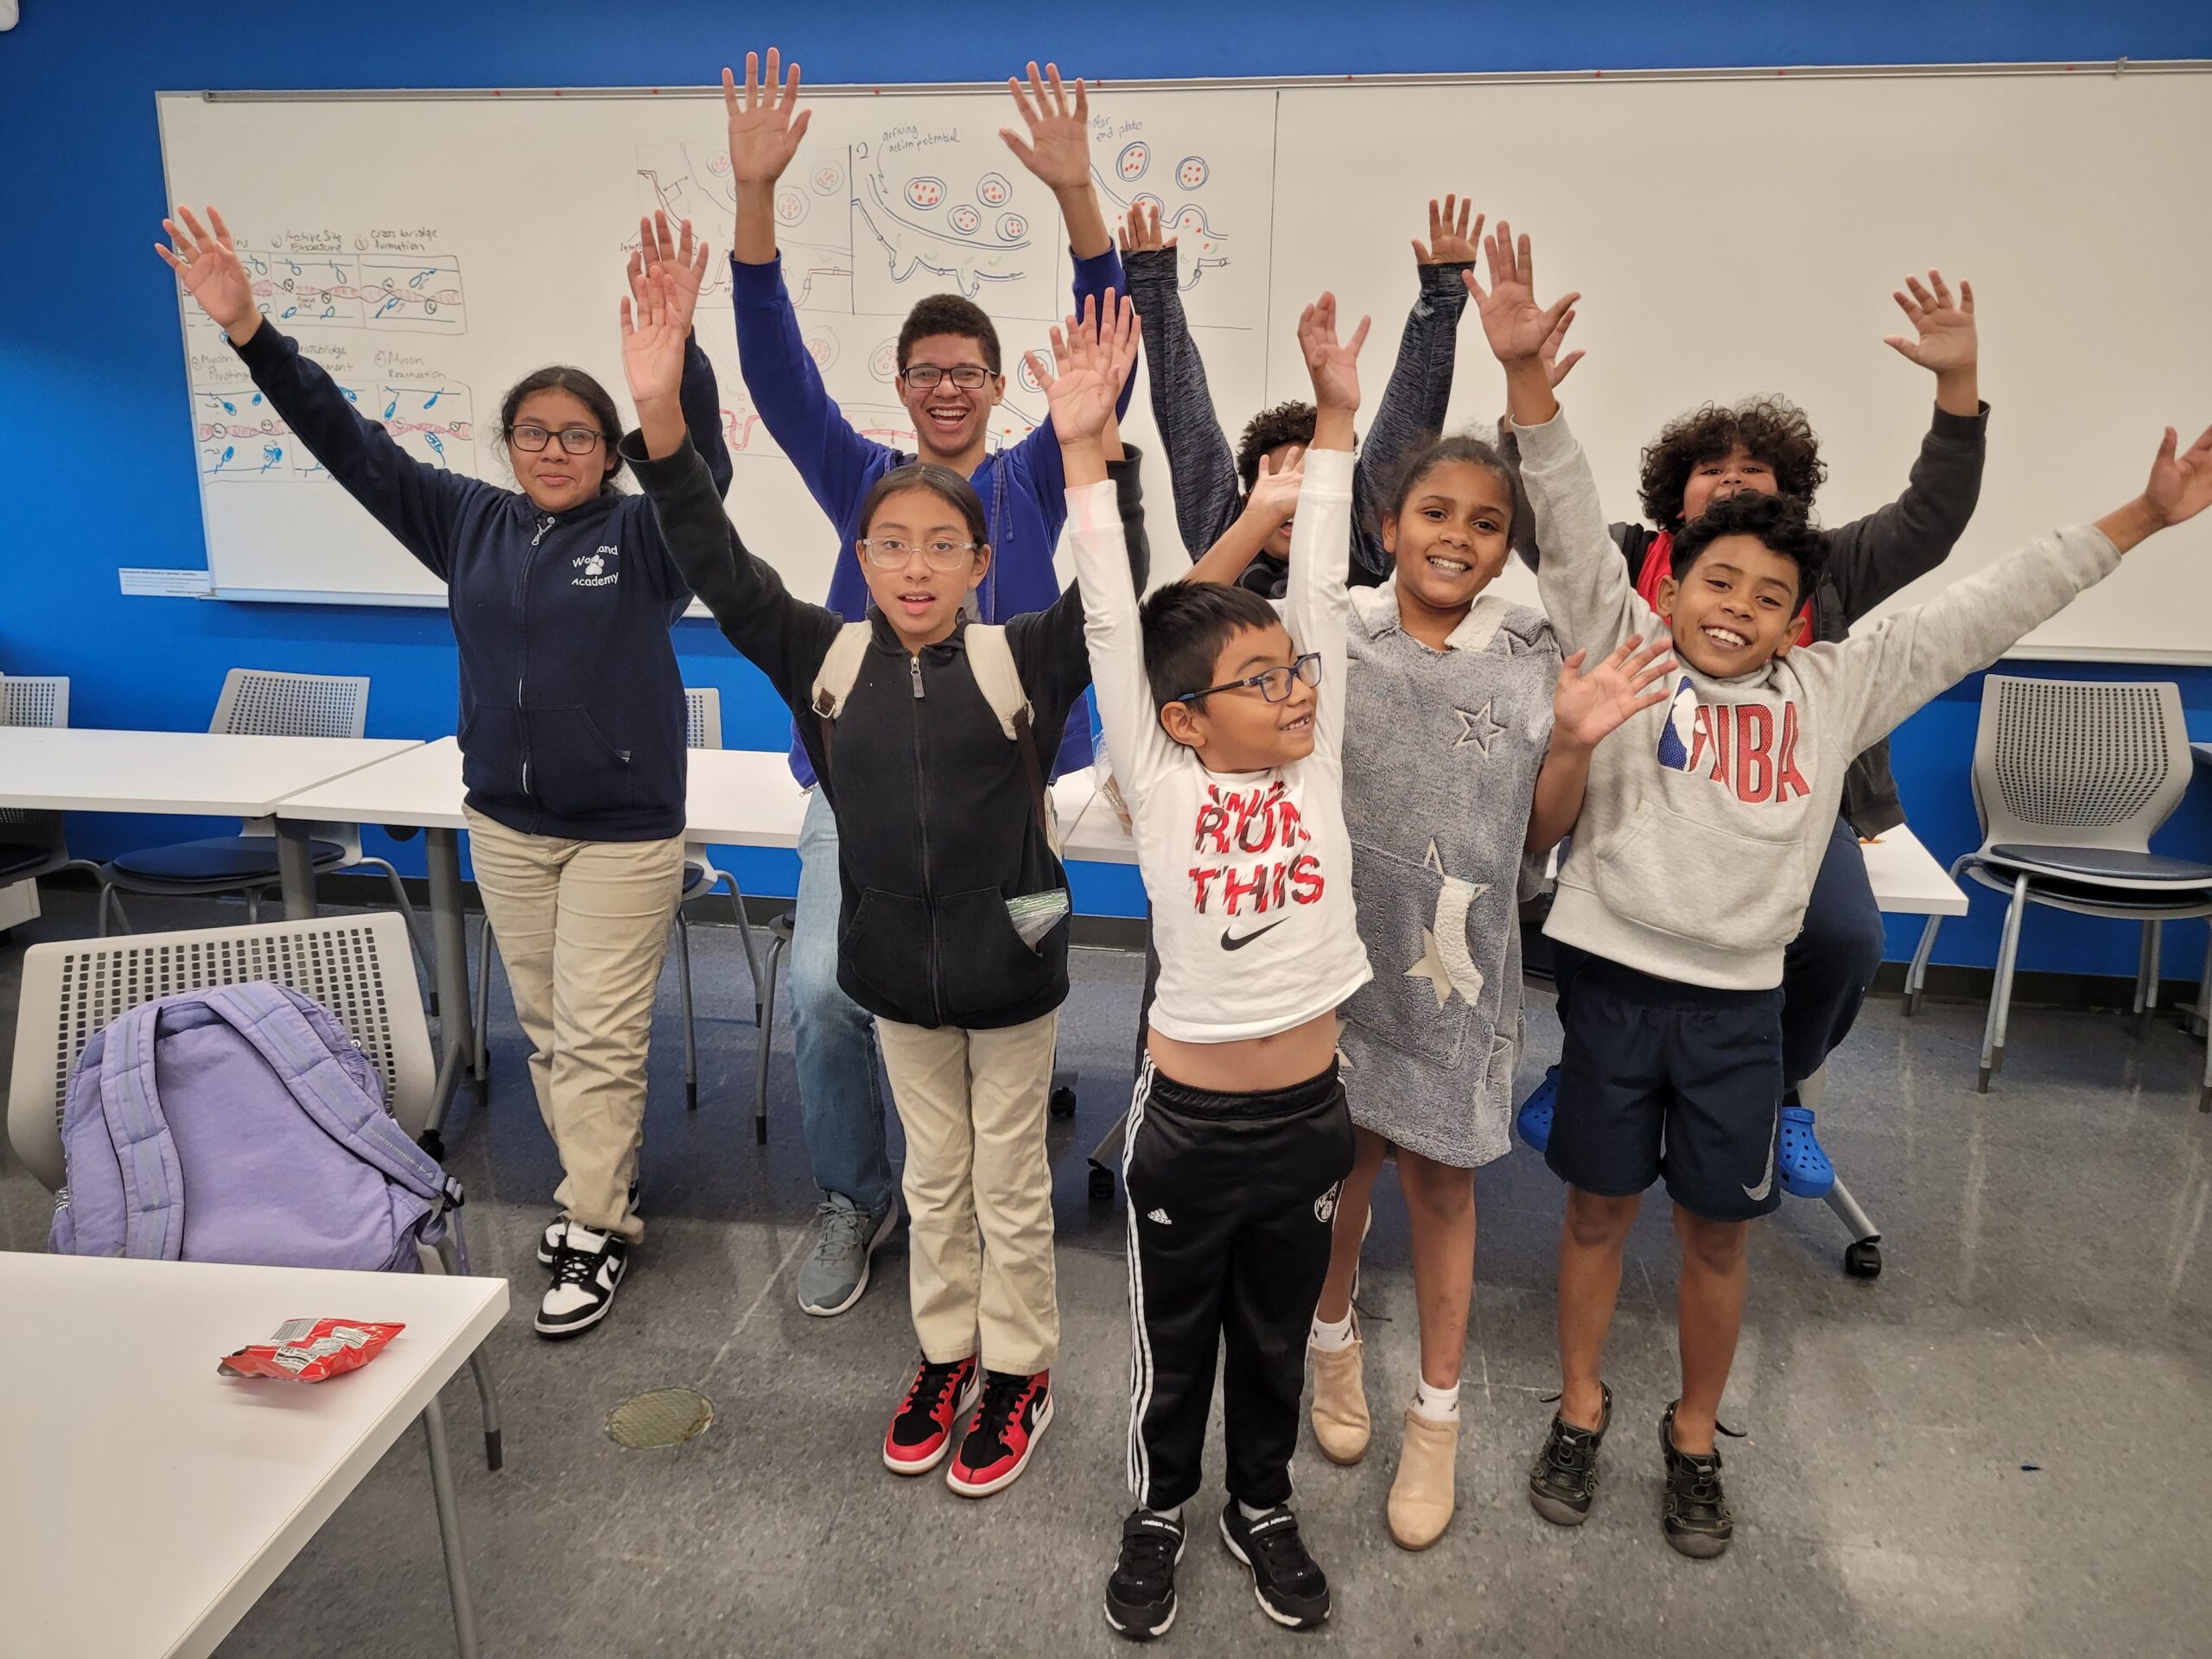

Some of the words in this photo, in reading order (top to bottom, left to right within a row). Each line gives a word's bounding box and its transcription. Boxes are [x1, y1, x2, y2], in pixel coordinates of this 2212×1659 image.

[882, 125, 918, 142] arriving
[917, 128, 961, 151] potential
[856, 142, 870, 159] 2
[300, 344, 346, 359] rossbridge
[571, 571, 620, 587] Academy
[1194, 801, 1312, 855] RUN
[1189, 855, 1325, 916] THIS
[1141, 1519, 1164, 1528] UNDER
[1249, 1521, 1270, 1535] UNDER
